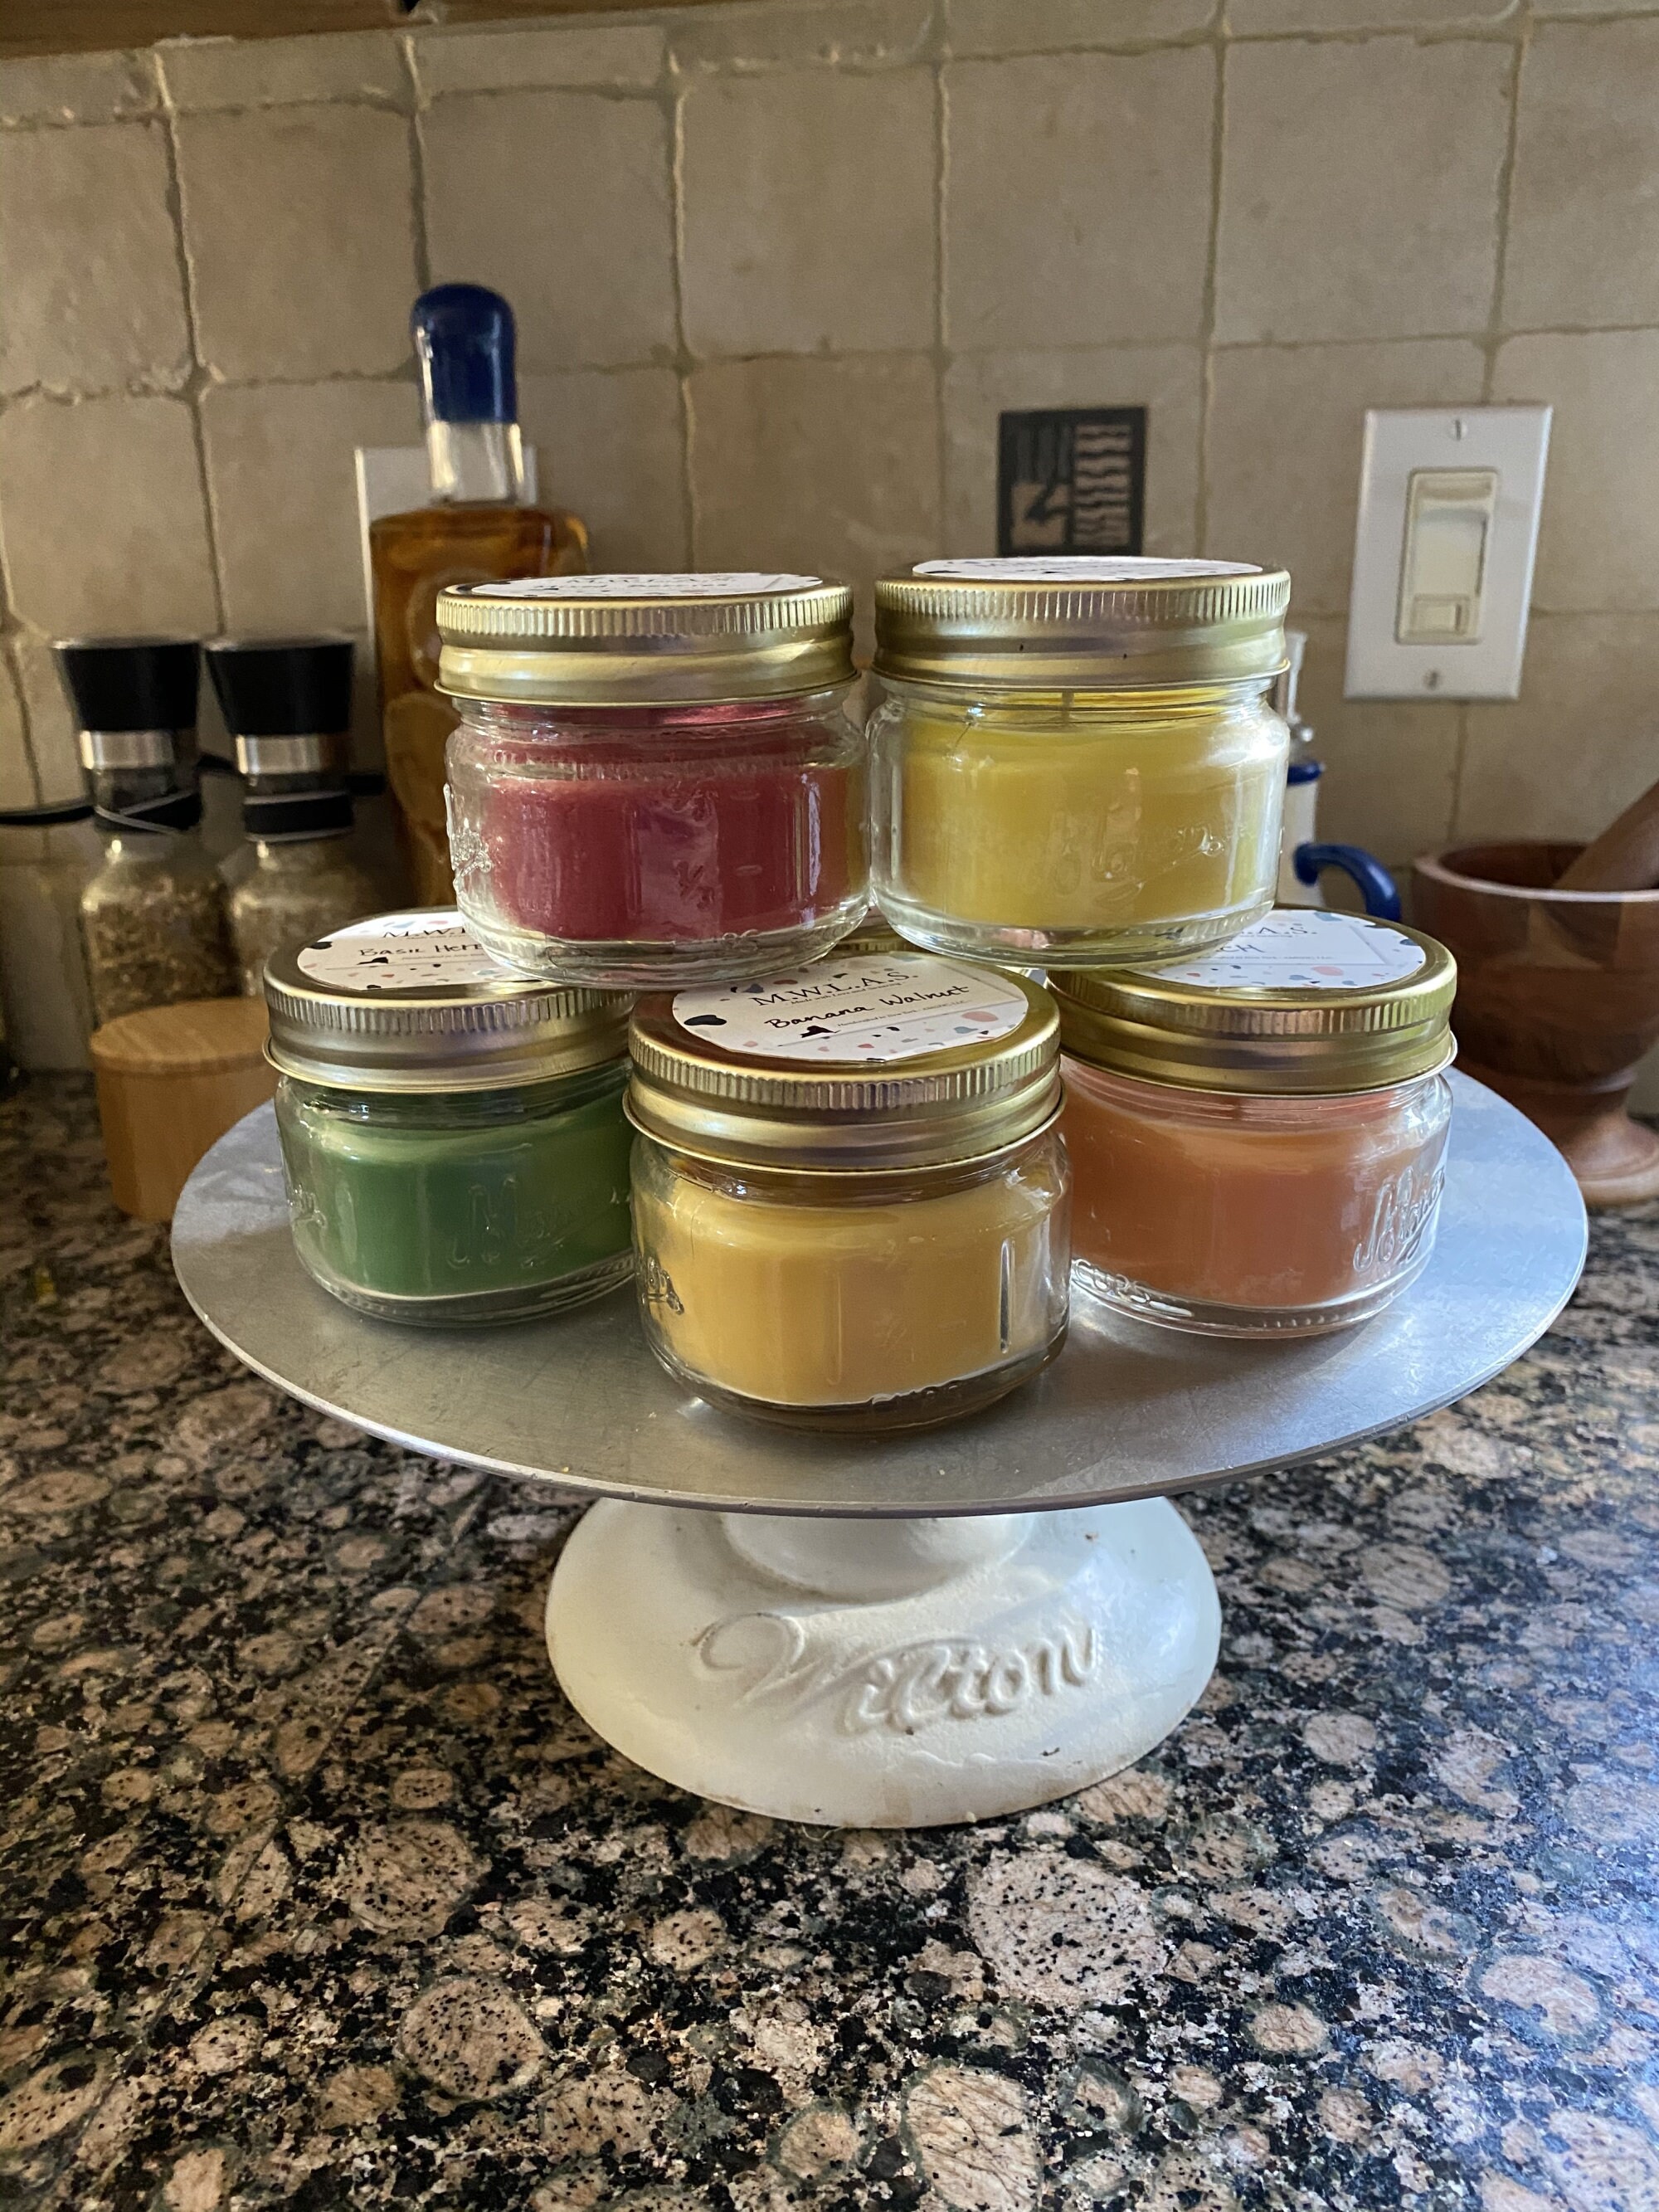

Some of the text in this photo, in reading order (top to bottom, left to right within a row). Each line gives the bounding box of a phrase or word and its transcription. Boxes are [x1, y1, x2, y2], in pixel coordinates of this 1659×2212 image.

[1240, 926, 1318, 935] .A.S.
[1216, 944, 1266, 953] CH
[752, 971, 919, 1006] M.W.L.A.S.
[763, 1005, 875, 1029] Banana
[879, 985, 970, 1006] Walnut
[699, 1611, 1099, 1734] Wilton
